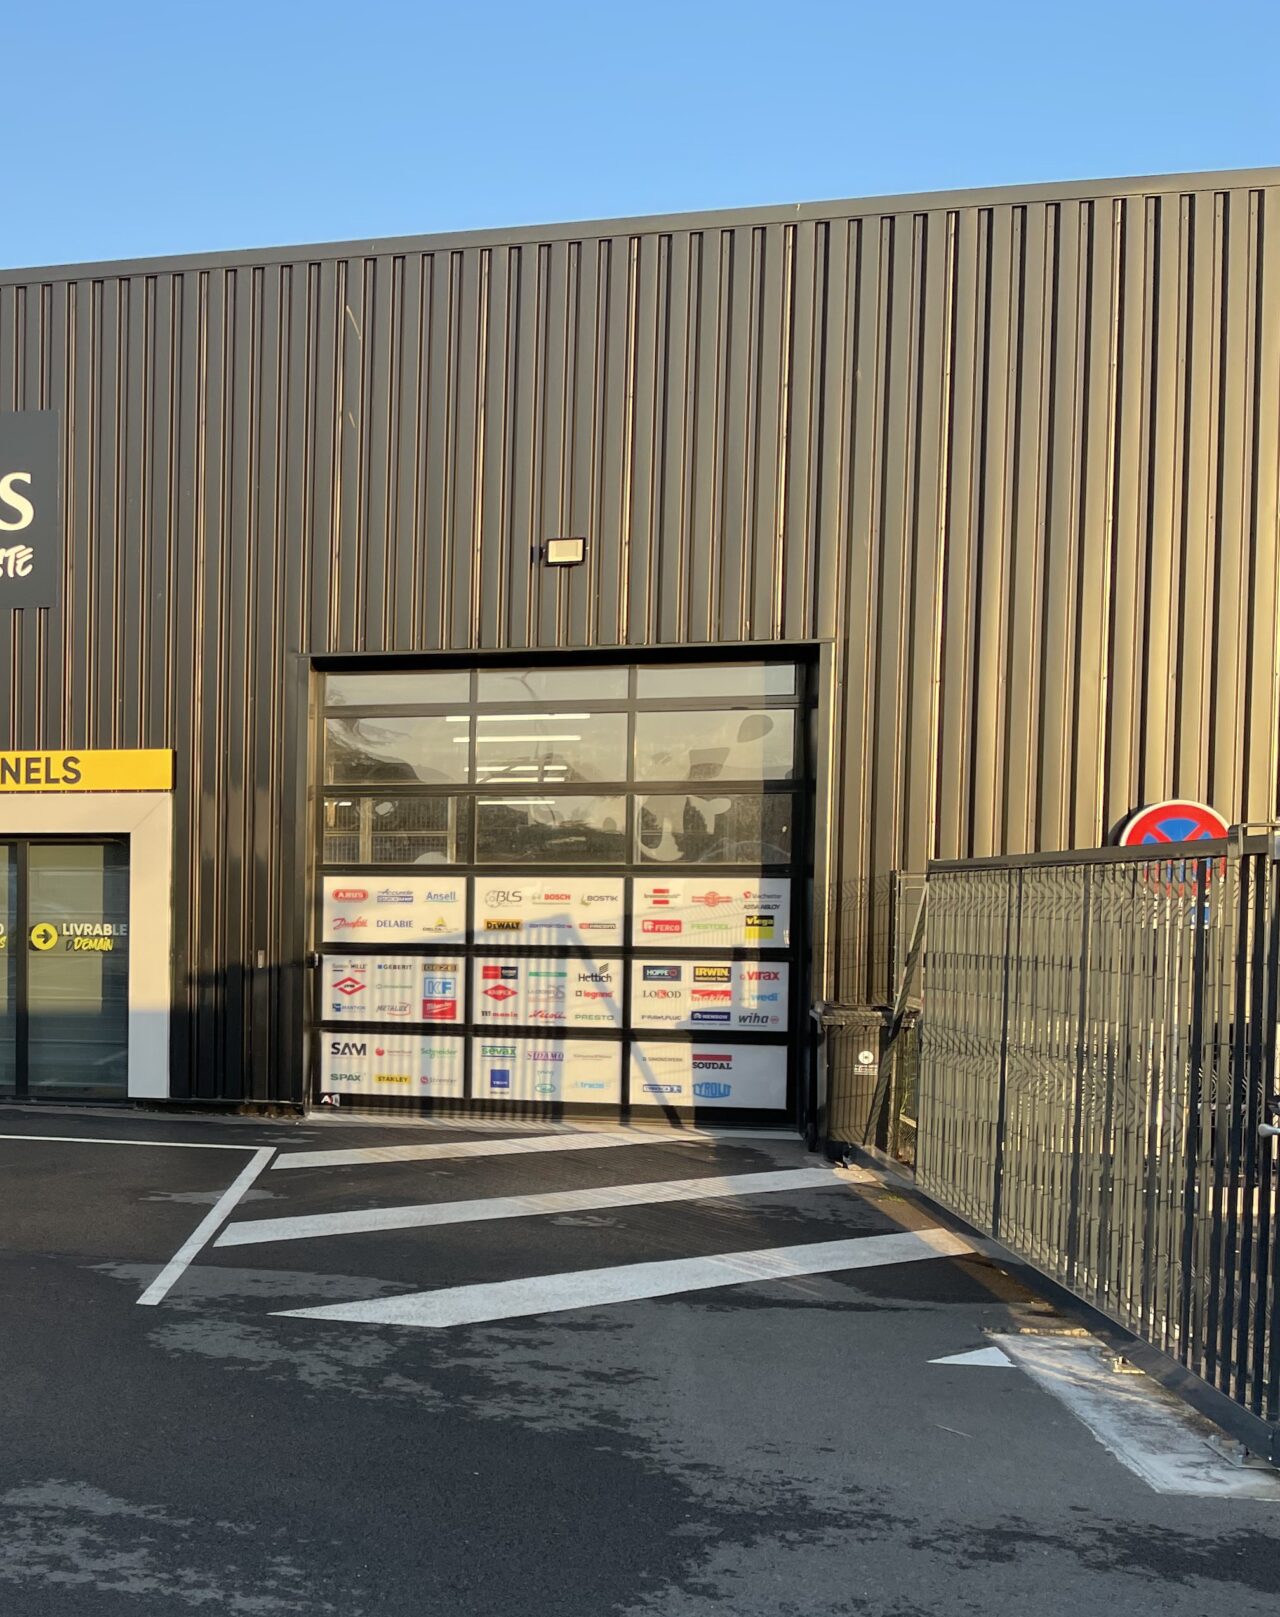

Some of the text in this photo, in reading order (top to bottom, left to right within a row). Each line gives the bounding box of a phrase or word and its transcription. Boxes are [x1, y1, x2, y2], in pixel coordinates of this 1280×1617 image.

[425, 891, 456, 901] Ansell
[496, 890, 523, 902] BLS
[543, 892, 571, 901] BOSCH
[586, 894, 619, 902] BOSTIK
[376, 919, 414, 928] DELABIE
[655, 924, 681, 932] FERCO
[61, 922, 128, 937] LIVRABLE
[73, 937, 114, 952] DEMAIN
[383, 962, 413, 970] GEBERIT
[578, 971, 612, 983] Hettich
[695, 967, 730, 977] IRWIN
[746, 970, 781, 981] virax
[583, 990, 614, 1000] legrand
[643, 990, 682, 999] LOKOD
[751, 993, 778, 1002] wedi
[738, 1013, 769, 1025] wiha
[331, 1042, 367, 1056] SAM
[692, 1062, 732, 1070] SOUDAL
[330, 1073, 361, 1082] SPAX
